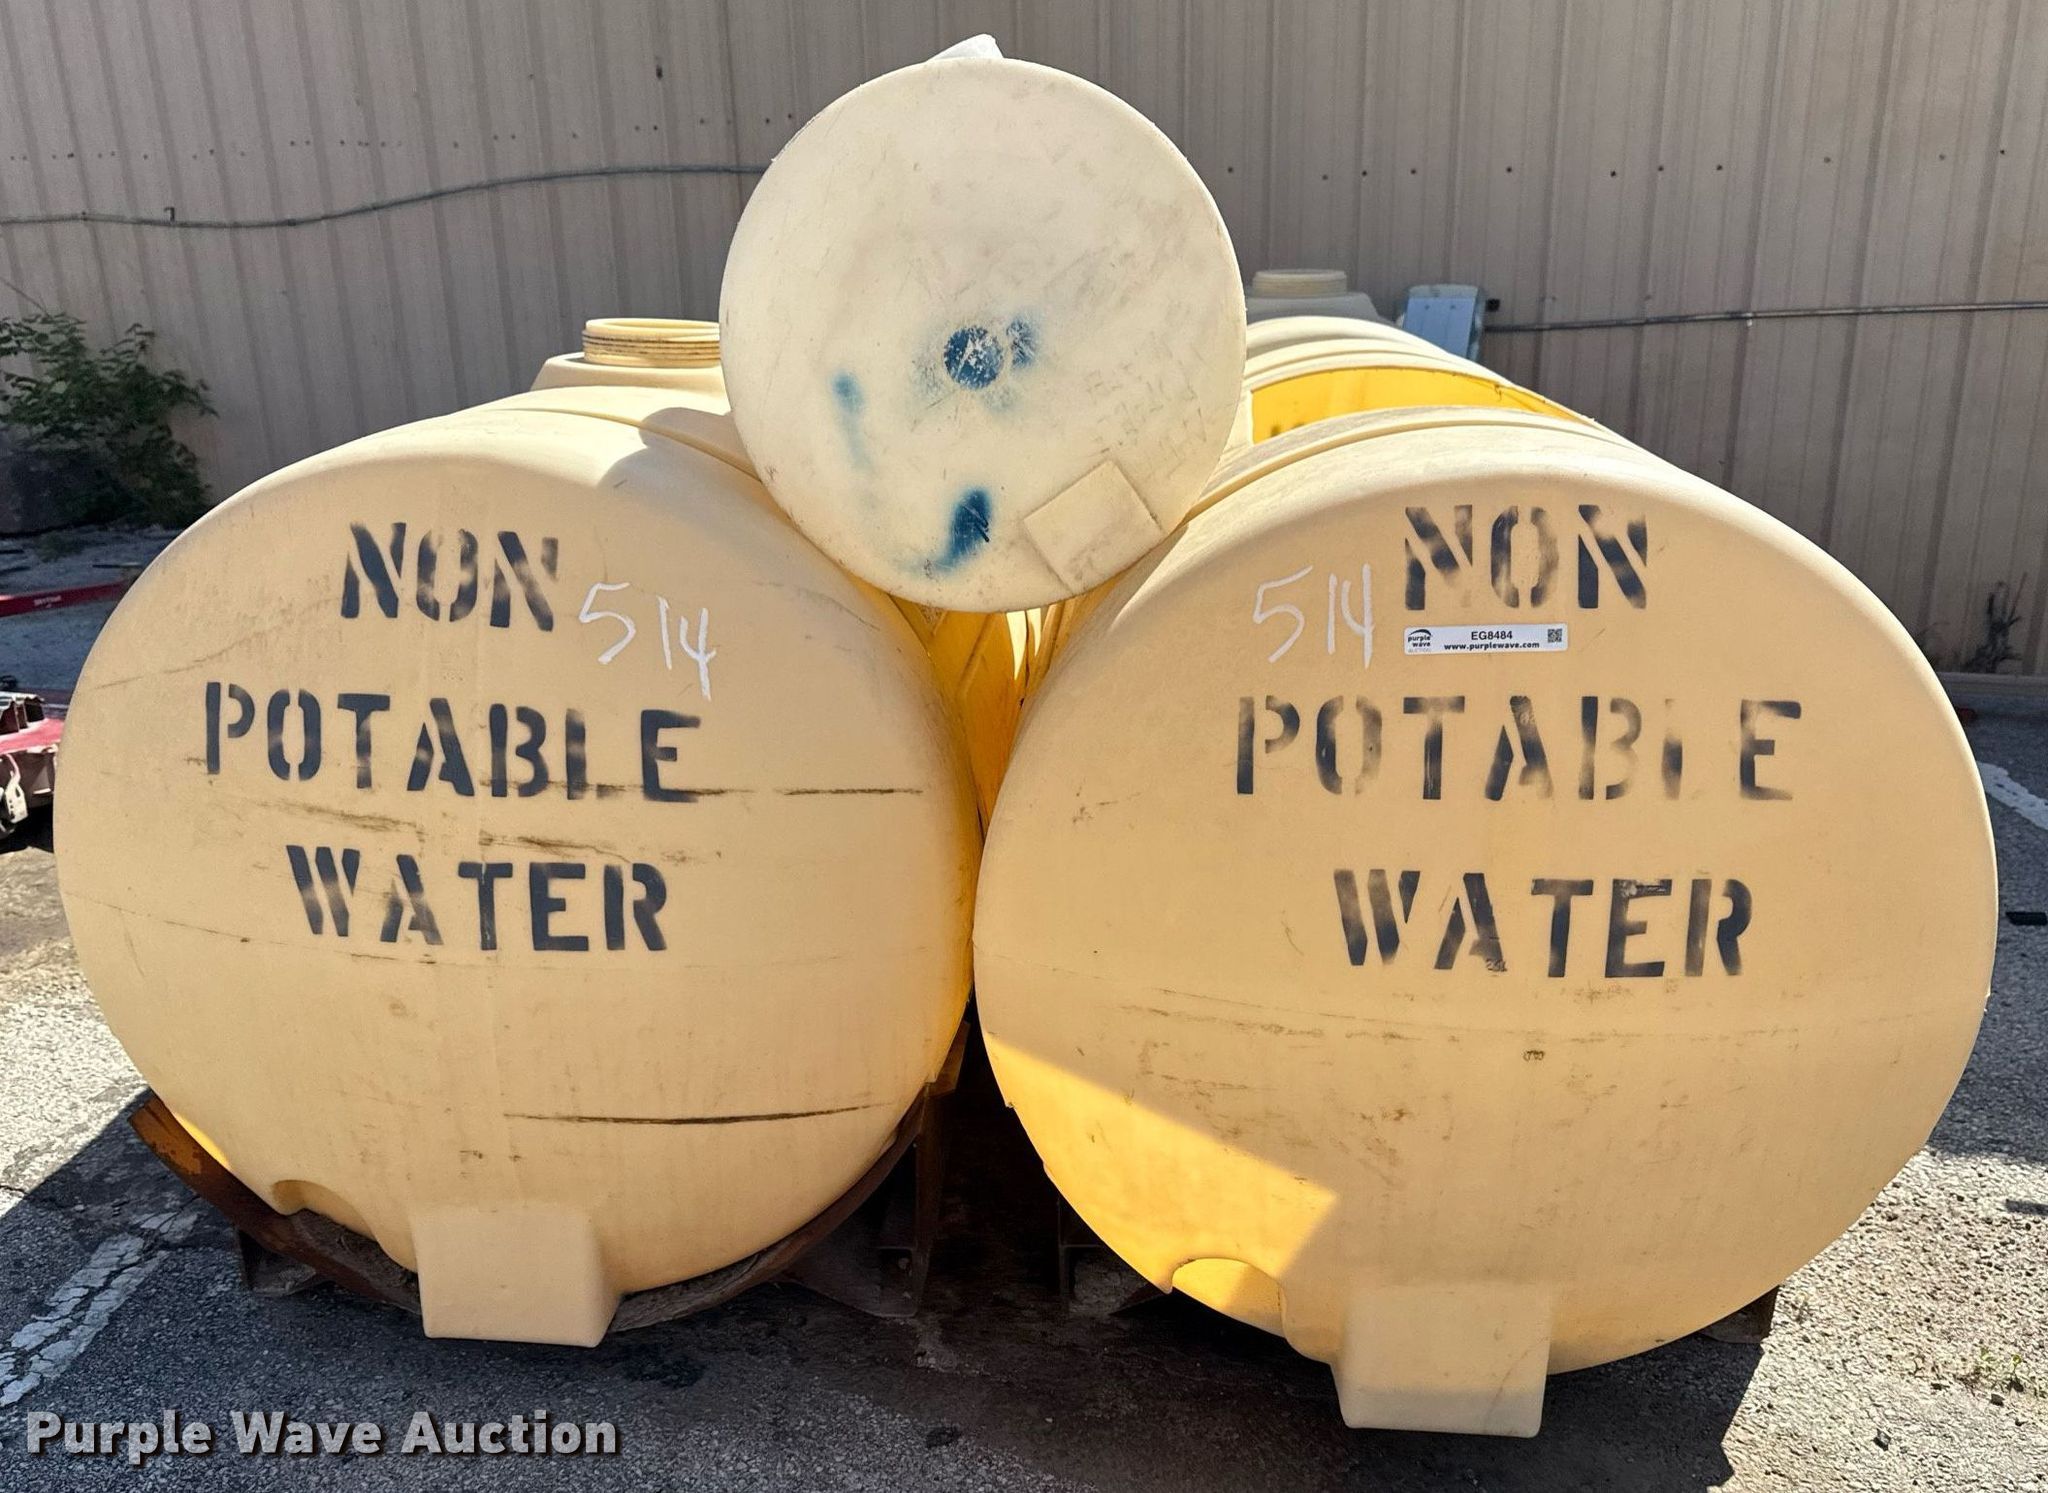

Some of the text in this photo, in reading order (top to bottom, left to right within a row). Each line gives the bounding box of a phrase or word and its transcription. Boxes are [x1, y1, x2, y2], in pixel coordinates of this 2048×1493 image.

[340, 521, 559, 632] NON
[1404, 503, 1648, 610] NON
[579, 581, 717, 701] 514
[1252, 562, 1377, 669] 514
[1407, 634, 1431, 643] purple
[1443, 641, 1540, 651] www.purplewave.com
[1471, 630, 1513, 641] EG8484
[205, 681, 702, 803] POTABLE
[286, 844, 668, 951] WATER
[1333, 868, 1752, 978] WATER
